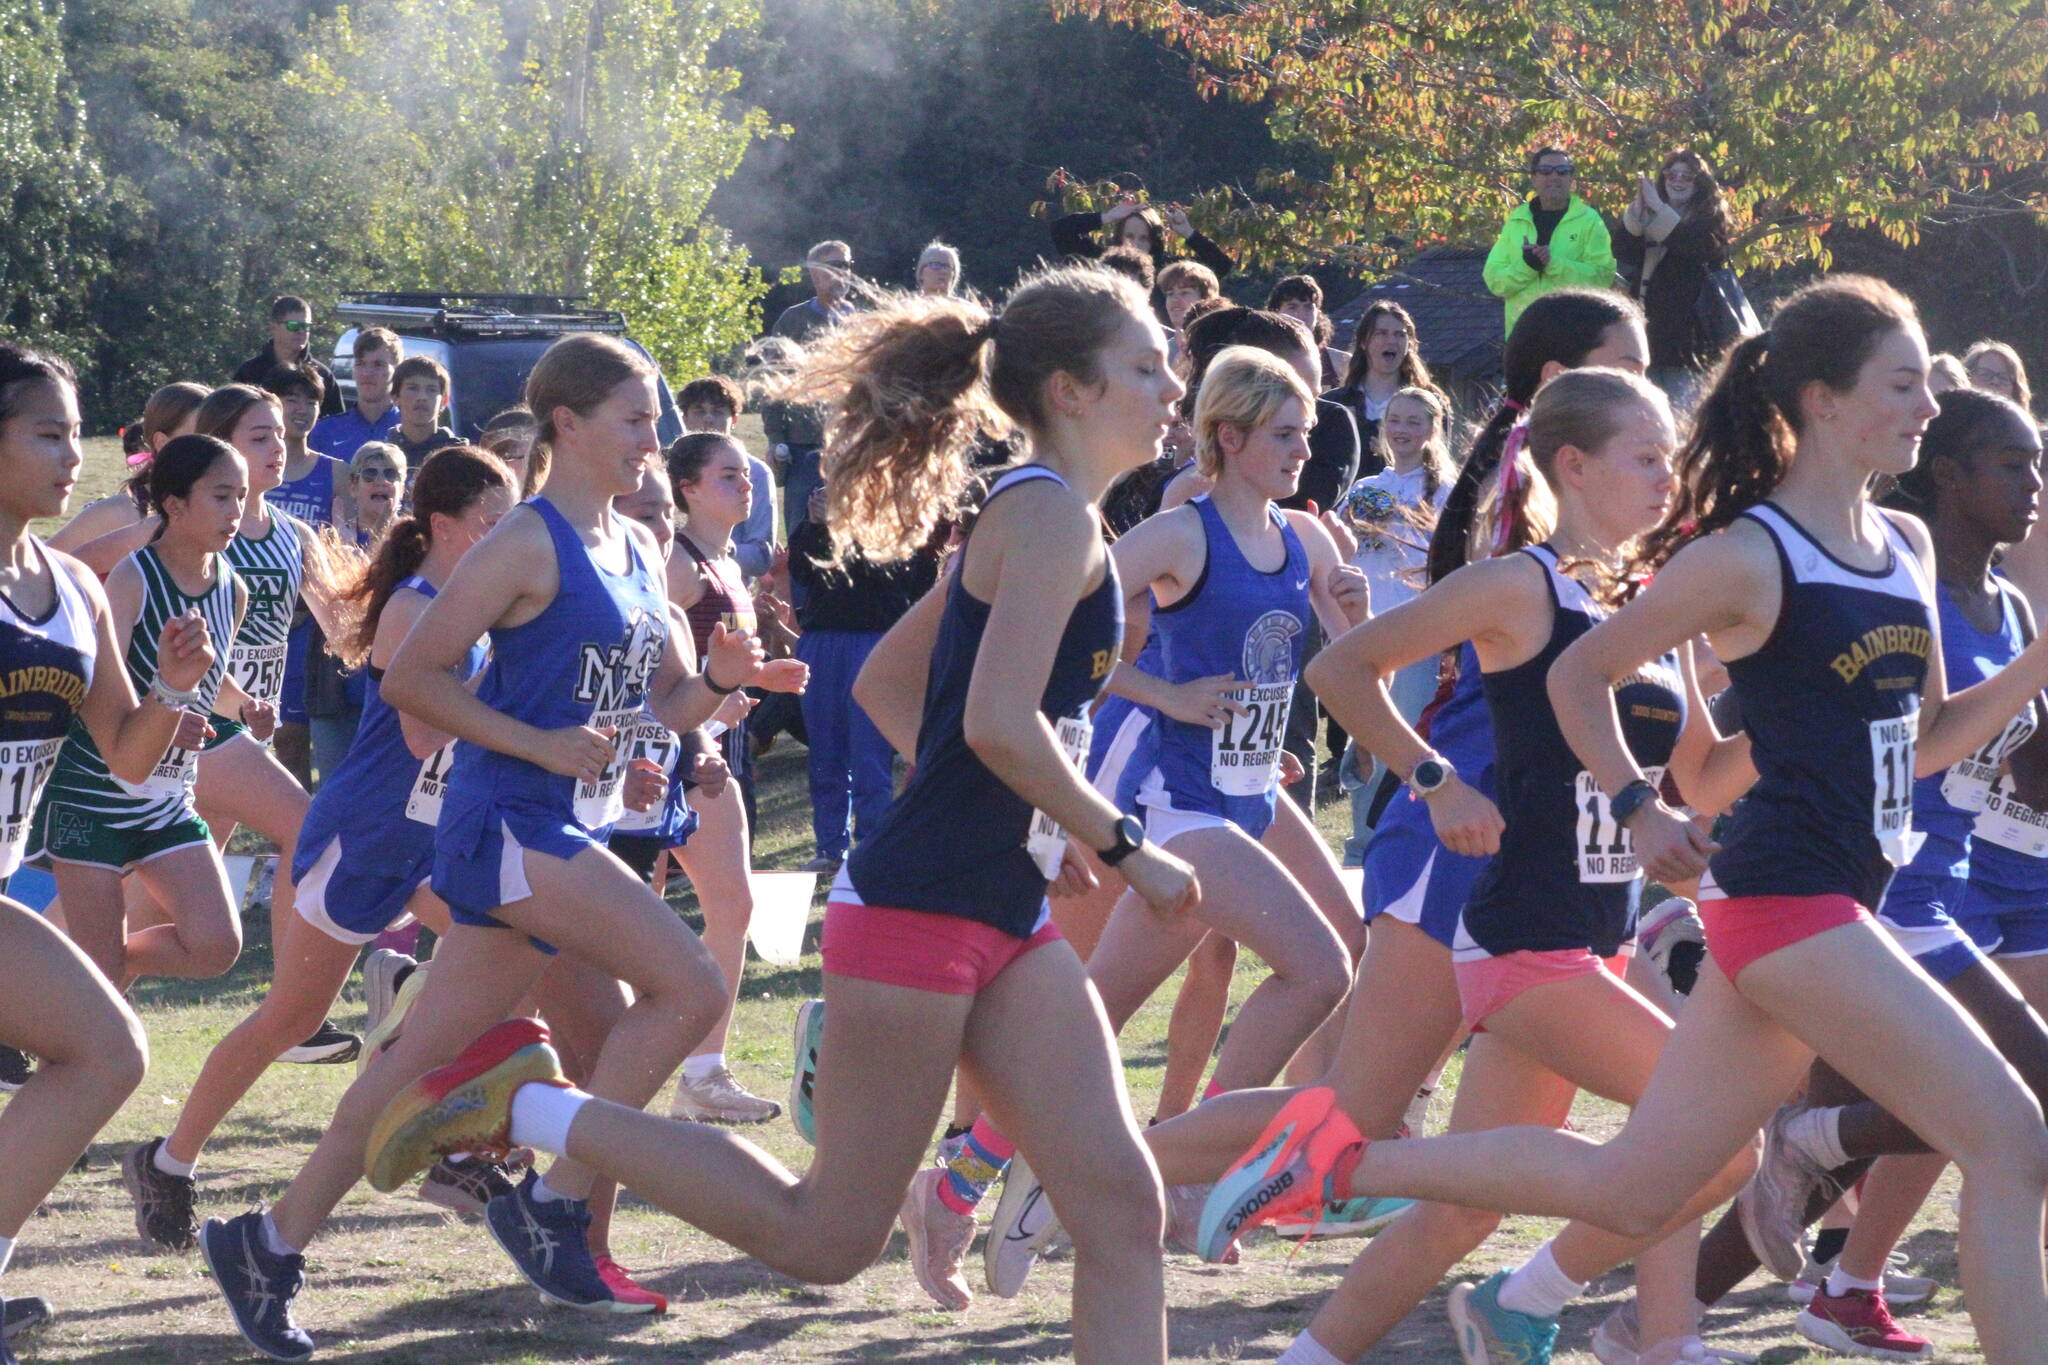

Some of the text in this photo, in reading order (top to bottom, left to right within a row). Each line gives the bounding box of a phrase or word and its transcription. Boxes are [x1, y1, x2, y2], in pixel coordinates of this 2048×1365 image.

[265, 499, 320, 526] MPIC
[247, 646, 284, 660] EXCUSES
[1830, 625, 1929, 685] BAINBRID
[1249, 686, 1289, 702] EXCUSES
[595, 715, 612, 728] NO
[1218, 702, 1288, 751] 1245
[637, 725, 671, 741] USES
[1061, 723, 1075, 746] NO
[1880, 725, 1899, 744] NO
[1219, 752, 1239, 767] NO
[152, 766, 180, 779] RETS
[1882, 743, 1916, 809] 11
[420, 780, 438, 796] NO
[580, 784, 598, 799] NO
[1585, 796, 1634, 854] 11
[1881, 811, 1899, 831] NO
[1587, 857, 1605, 874] NO
[1226, 1170, 1295, 1235] BROOKS
